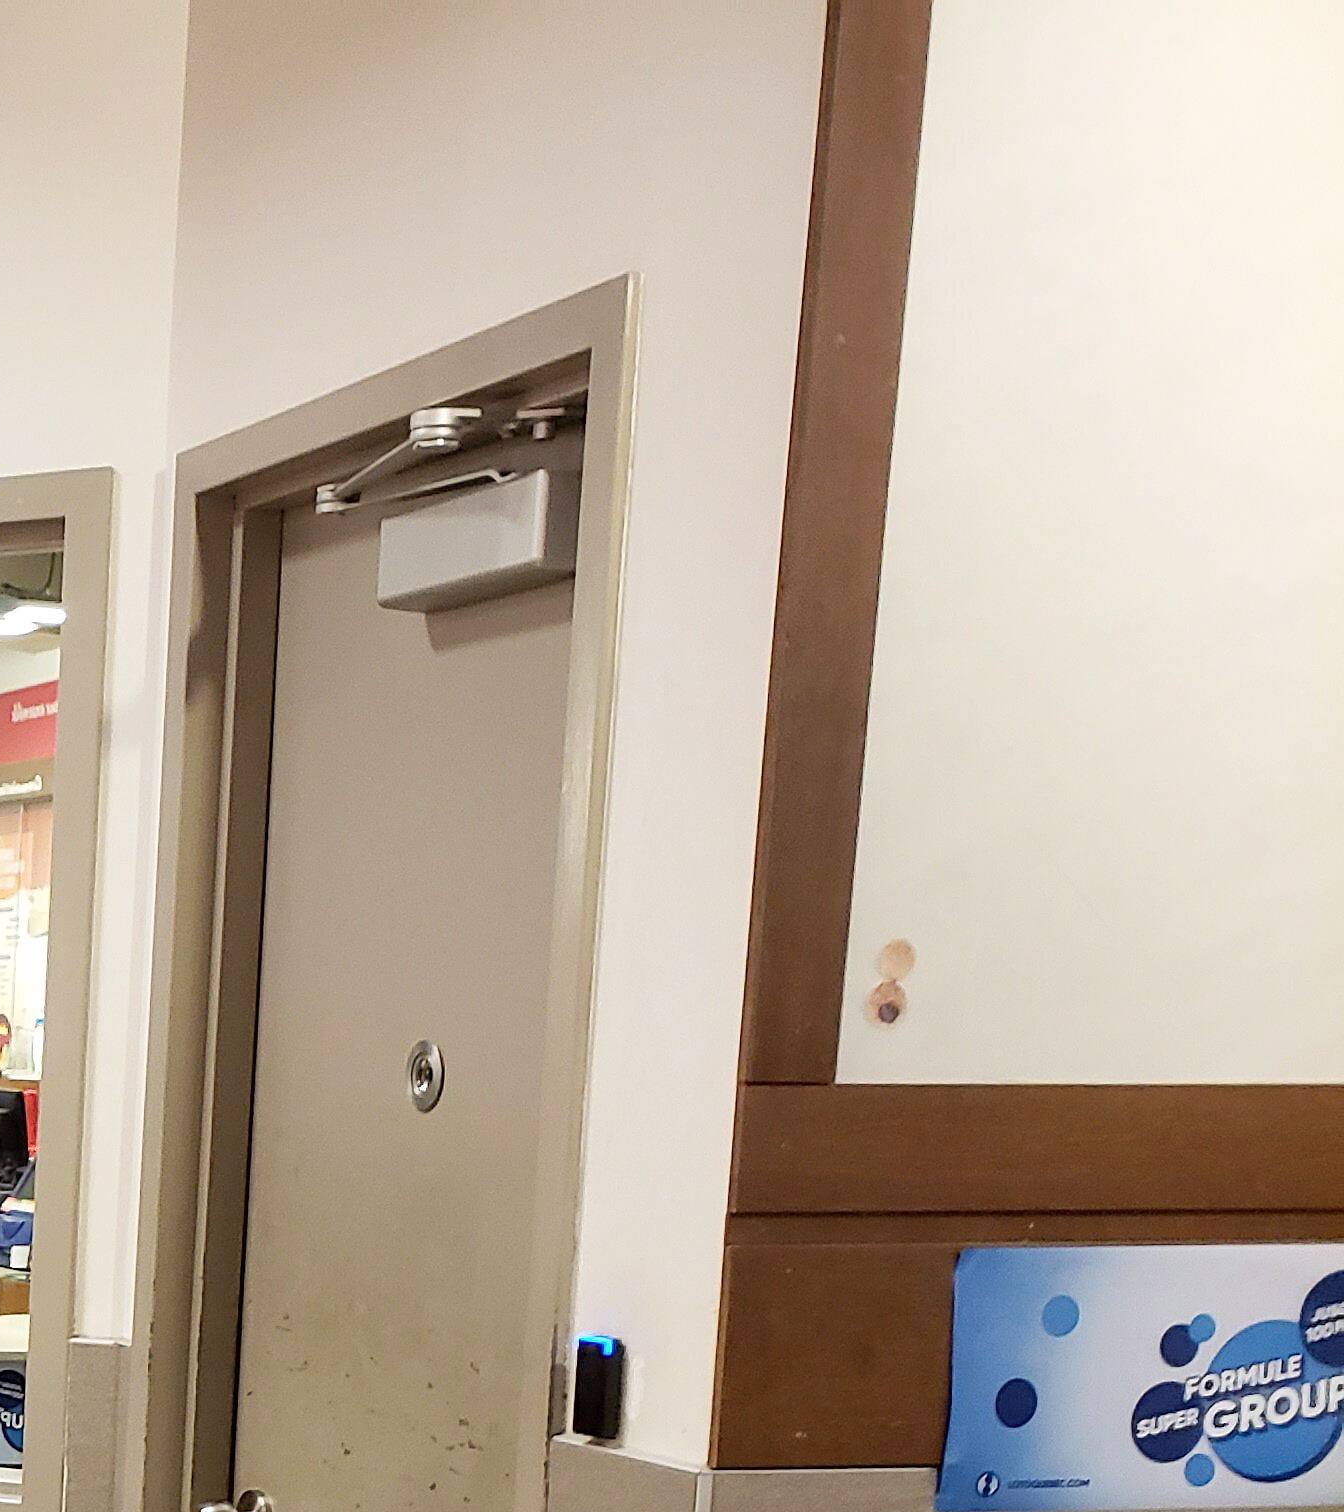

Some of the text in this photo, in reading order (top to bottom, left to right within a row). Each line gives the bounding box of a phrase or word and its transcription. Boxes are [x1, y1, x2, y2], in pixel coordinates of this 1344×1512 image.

[1183, 1353, 1303, 1402] FORMULE
[1135, 1374, 1344, 1439] SUPER GROUP
